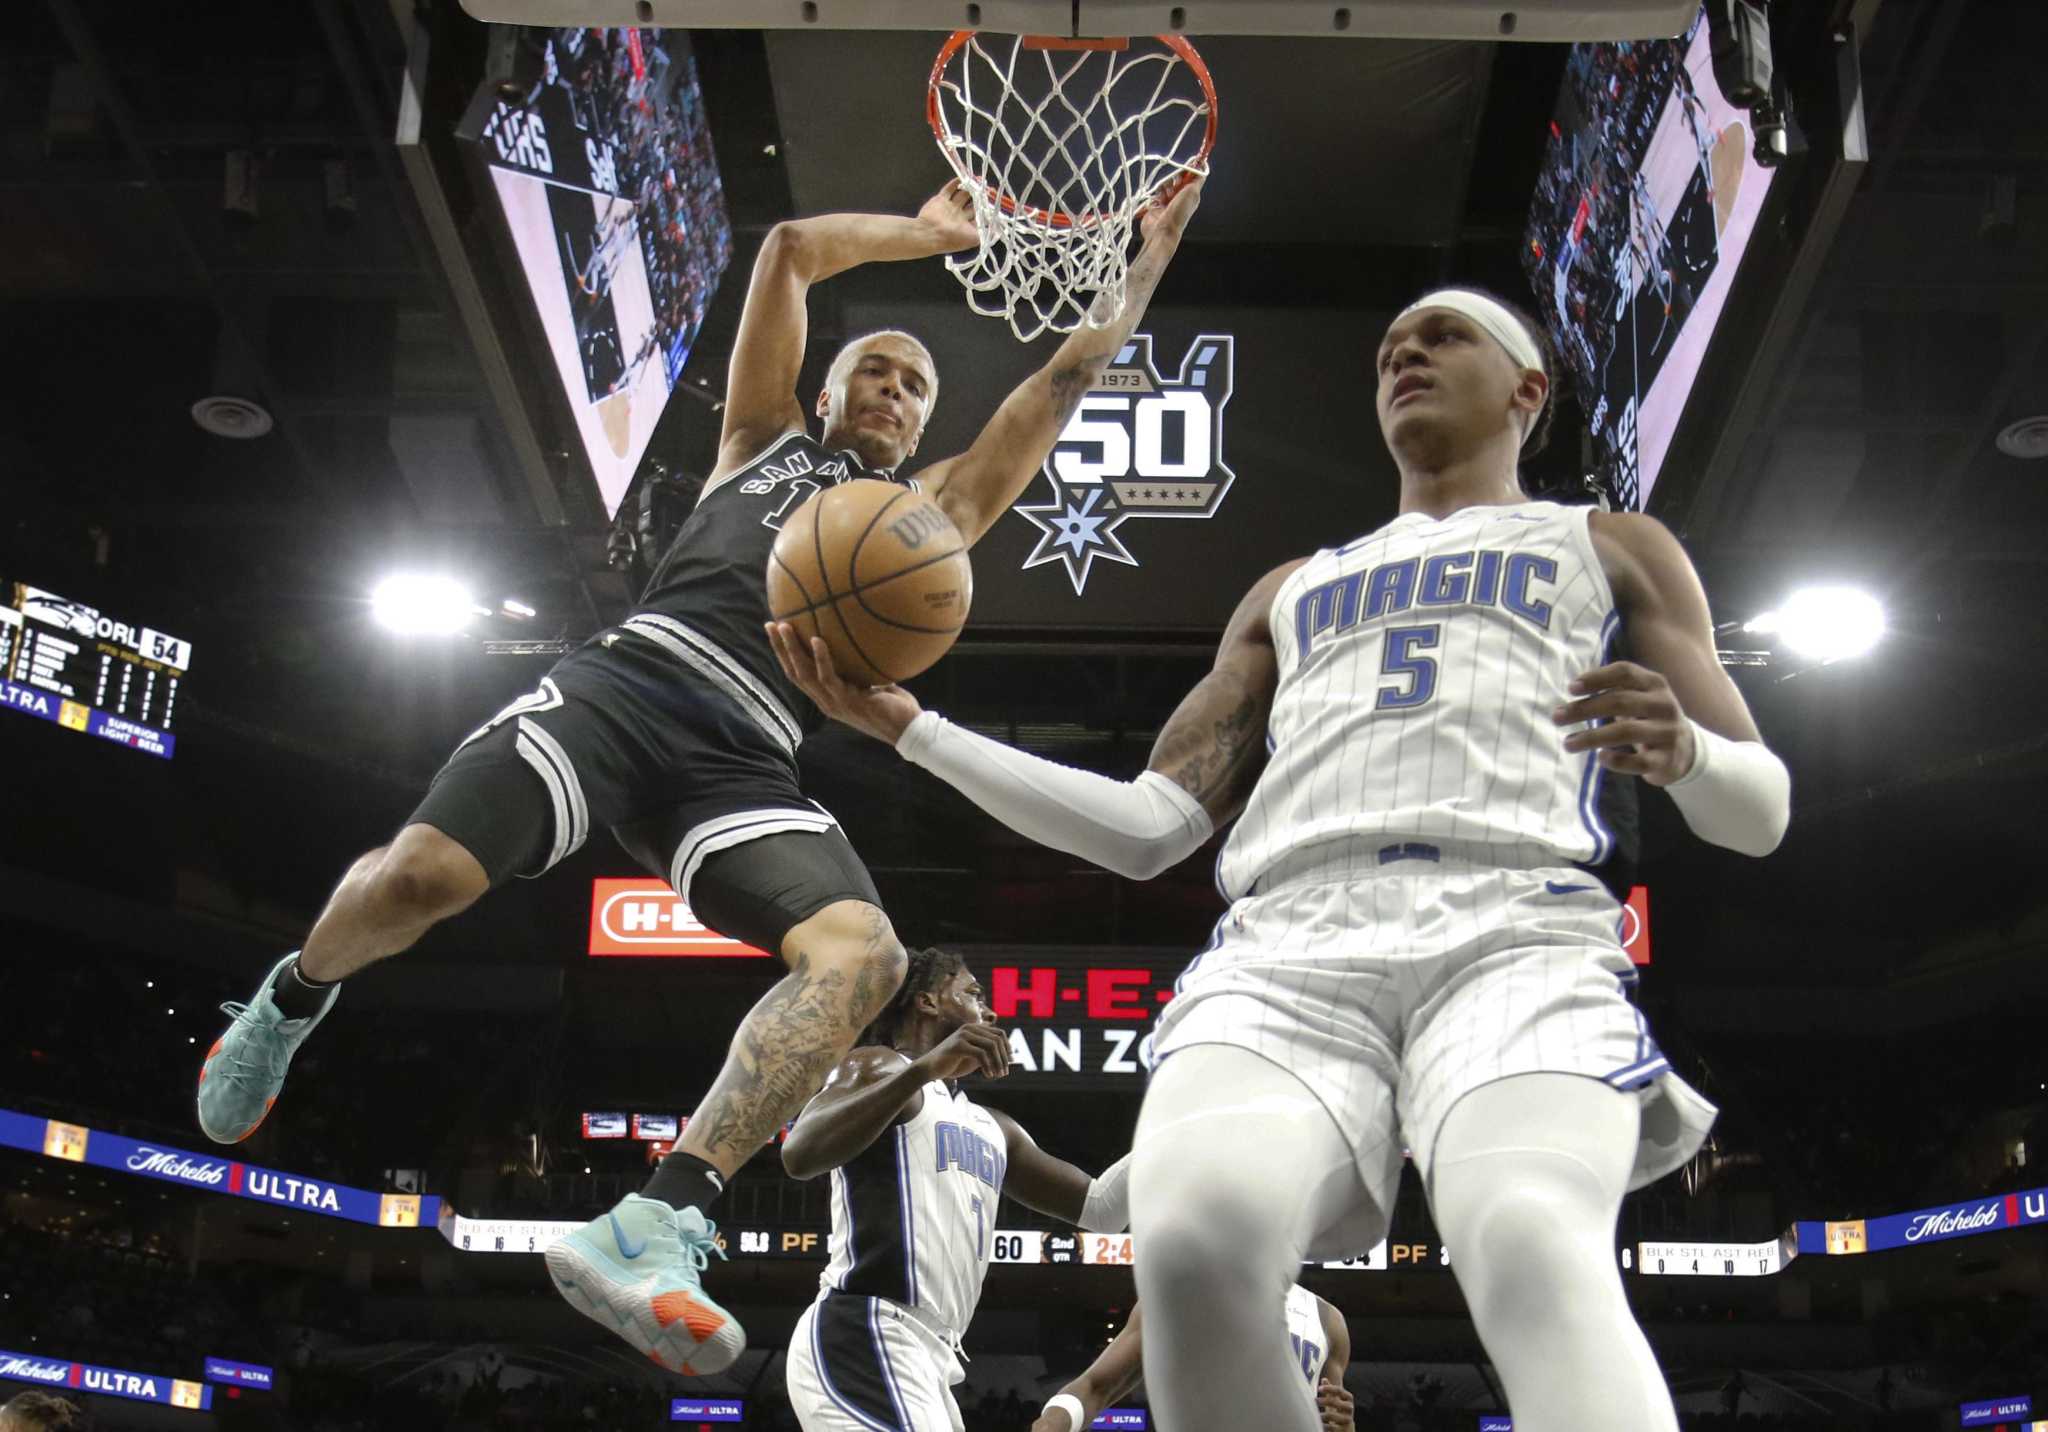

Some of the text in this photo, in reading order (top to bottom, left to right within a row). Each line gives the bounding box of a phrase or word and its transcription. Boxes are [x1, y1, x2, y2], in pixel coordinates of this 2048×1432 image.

[1101, 375, 1141, 387] 1973
[1054, 391, 1211, 483] 50
[740, 450, 813, 494] SAN
[1294, 550, 1558, 669] MAGIC
[97, 617, 140, 649] ORL
[152, 635, 179, 664] 54
[1374, 624, 1440, 711] 5
[99, 725, 165, 754] LIGHT BEER
[107, 717, 160, 741] SUPERIOR
[935, 1121, 1005, 1194] MAGI
[127, 1147, 339, 1211] Michelob ULTRA
[1905, 1202, 2000, 1242] Michelob
[782, 1233, 818, 1252] PF
[994, 1235, 1023, 1260] 60
[1051, 1237, 1075, 1250] 2nd
[1392, 1244, 1428, 1263] PF
[1646, 1246, 1775, 1258] BLK STL AST REB
[1052, 1252, 1071, 1263] QTR
[1658, 1258, 1768, 1274] 0 4 10 17
[84, 1369, 157, 1398] ULTRA
[241, 1369, 270, 1383] ULTRA
[709, 1405, 740, 1416] ULTRA
[1112, 1415, 1143, 1425] ULTRA
[1998, 1402, 2028, 1416] ULTRA
